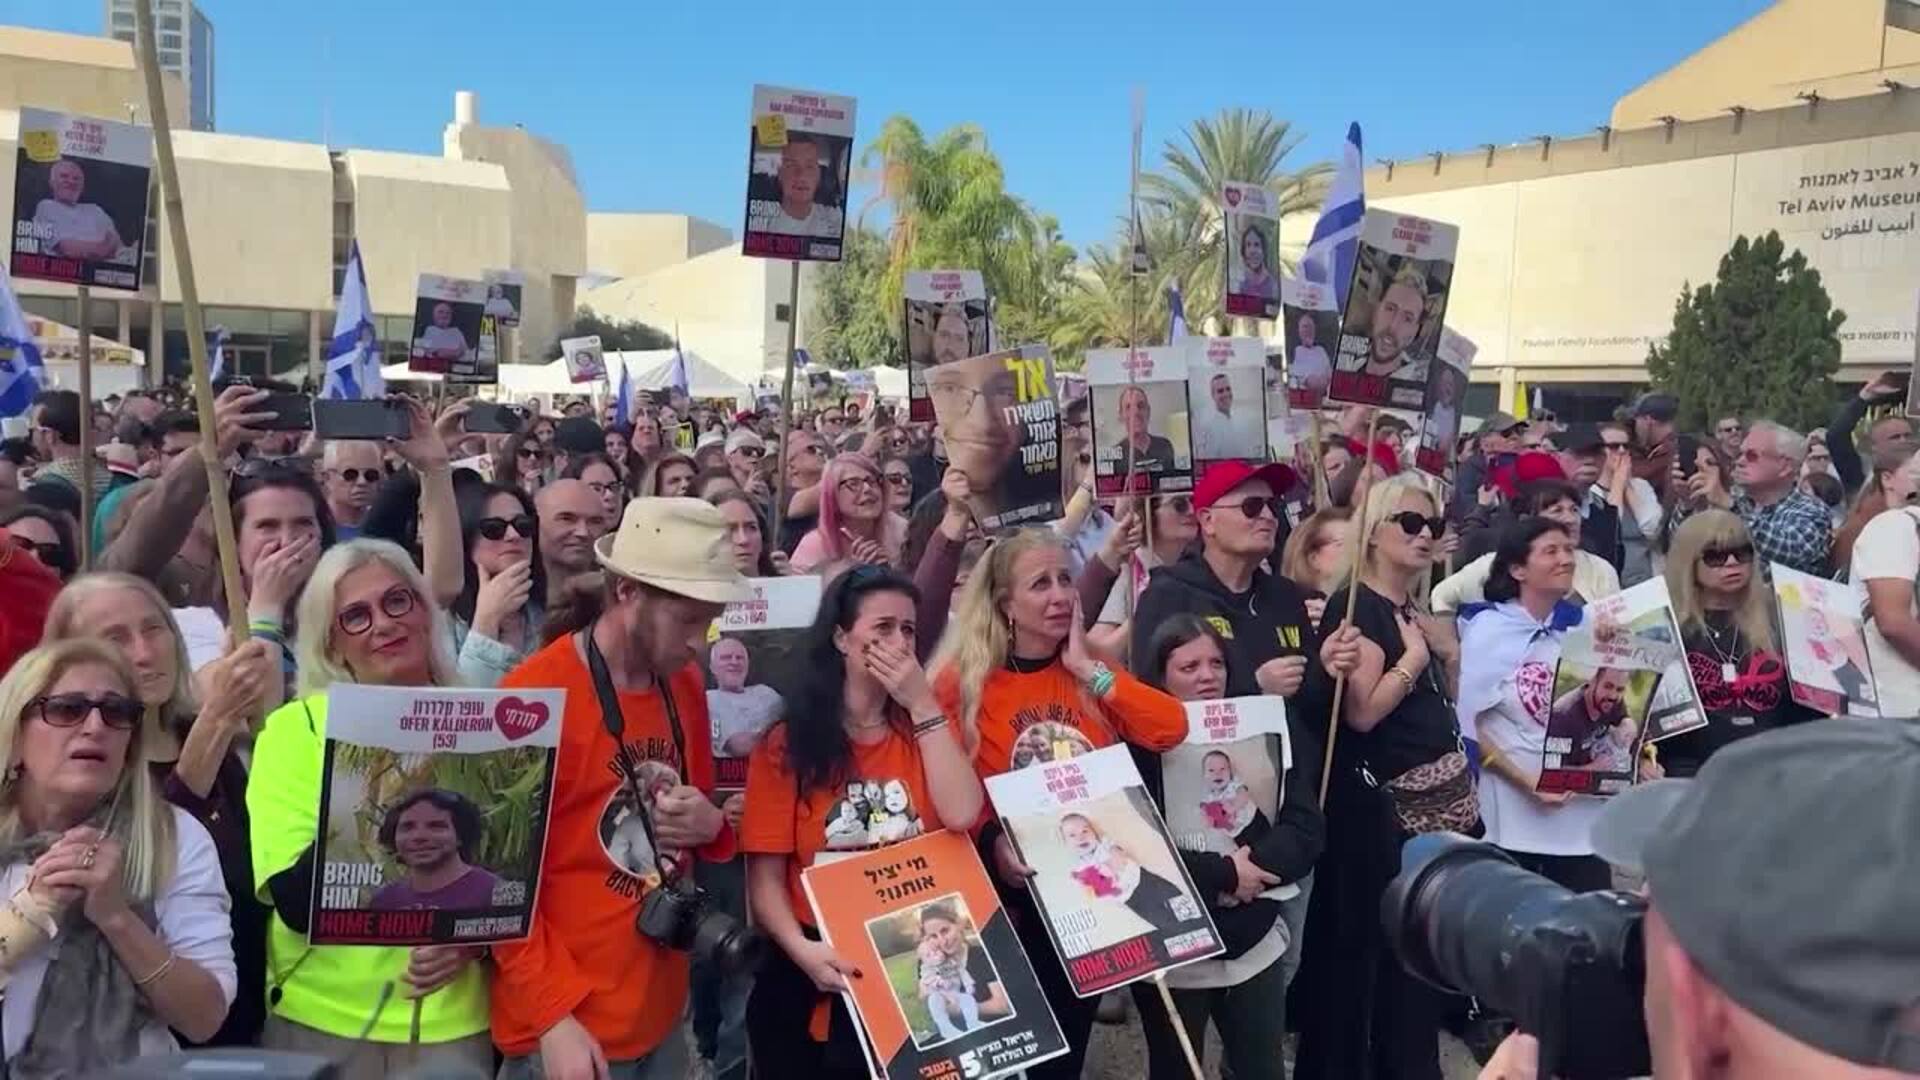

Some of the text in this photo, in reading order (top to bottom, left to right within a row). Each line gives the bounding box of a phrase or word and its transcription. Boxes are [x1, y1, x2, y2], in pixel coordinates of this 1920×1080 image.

[1799, 168, 1859, 189] לאמנות
[1863, 165, 1904, 182] אביב
[1779, 191, 1920, 215] Tel Aviv Museu
[17, 220, 52, 237] BRING
[15, 237, 39, 254] HIM
[1005, 356, 1050, 402] אל
[1028, 421, 1057, 442] אותי
[1019, 440, 1058, 465] מאחור
[413, 699, 485, 717] עופר קלדרון
[400, 716, 494, 732] OFER KALDERON
[432, 732, 458, 749] (53)
[323, 862, 384, 886] BRING
[864, 854, 929, 886] מי יציל
[605, 868, 647, 901] BACK
[875, 874, 938, 903] אותנו?
[320, 886, 360, 909] HIM
[319, 909, 433, 935] HOME NOW!
[1070, 952, 1113, 984] HOME
[1110, 935, 1153, 969] NOW!
[1002, 1029, 1035, 1047] אריאל
[959, 1049, 982, 1079] 5
[991, 1042, 1039, 1066] יום הולדת
